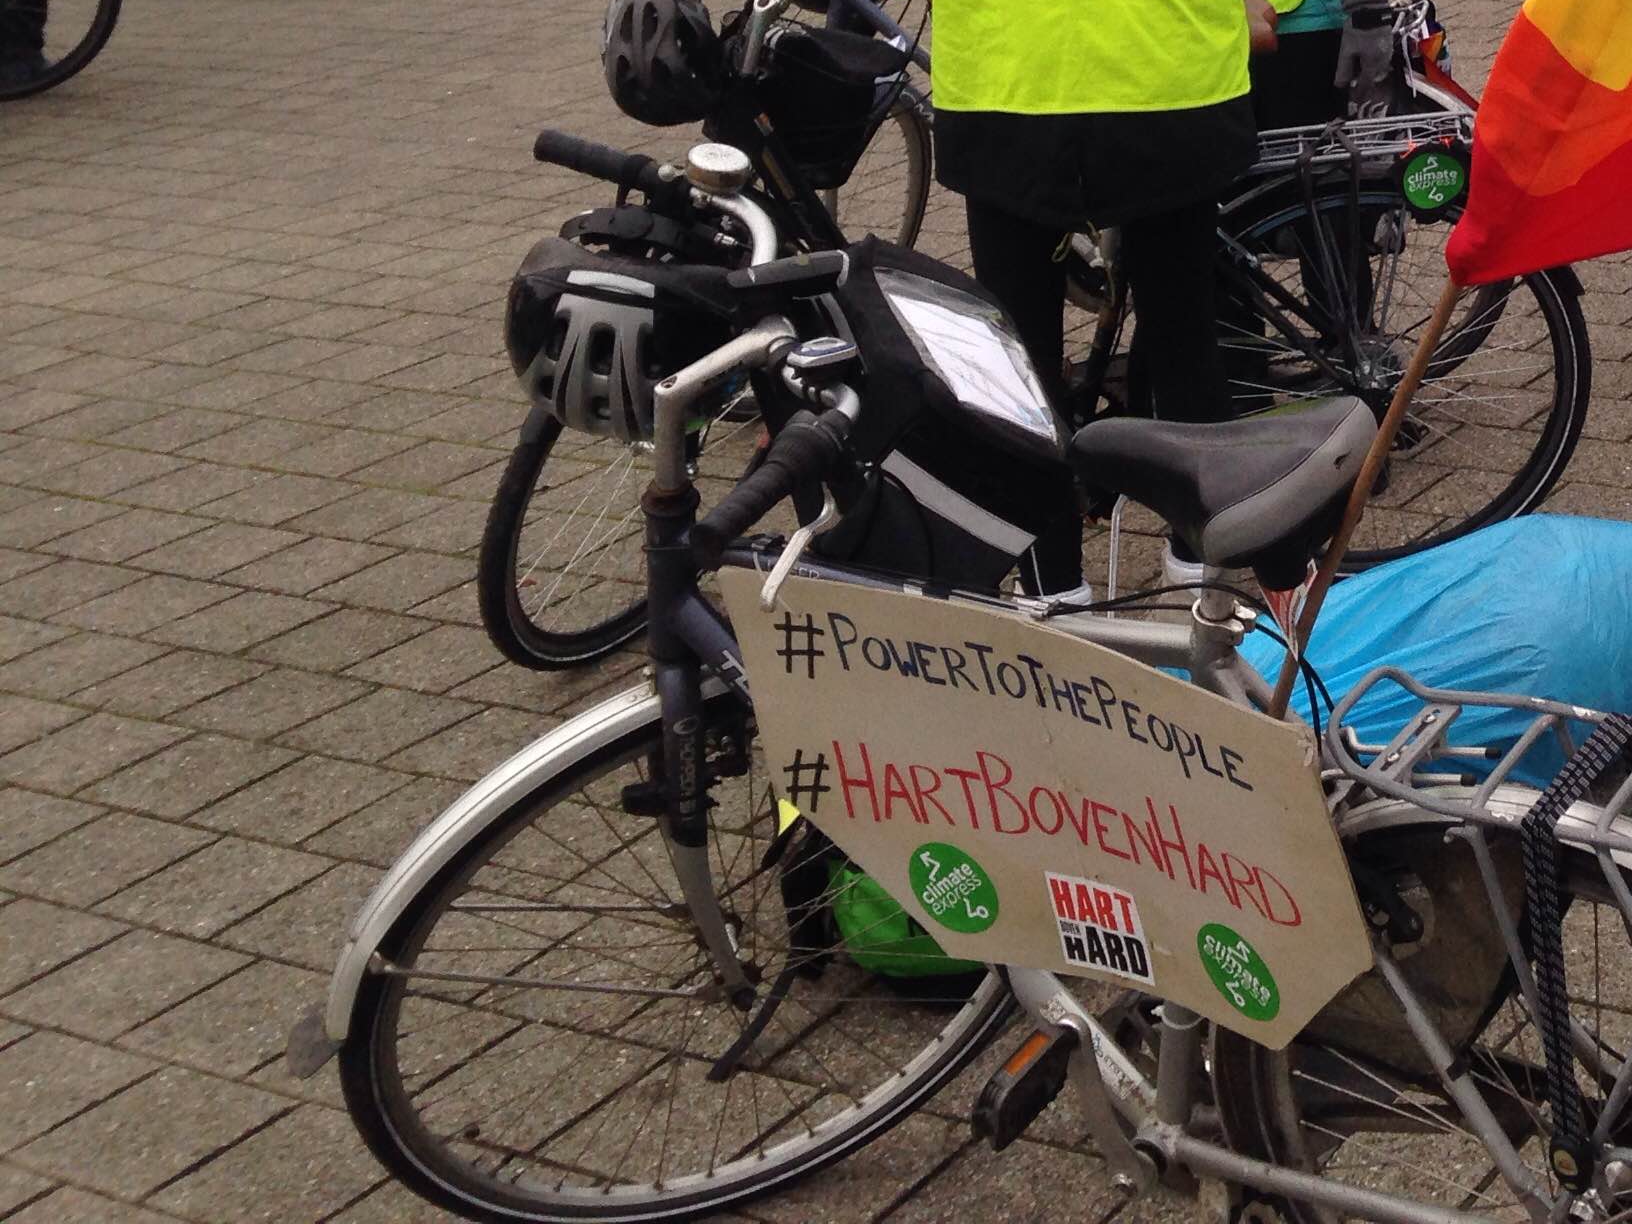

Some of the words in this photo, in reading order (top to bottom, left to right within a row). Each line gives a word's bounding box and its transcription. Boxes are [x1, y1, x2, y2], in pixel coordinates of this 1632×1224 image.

[1407, 169, 1458, 185] climate
[922, 862, 974, 905] climate
[931, 875, 982, 916] express
[1049, 878, 1135, 935] HART
[1063, 925, 1150, 978] HARD
